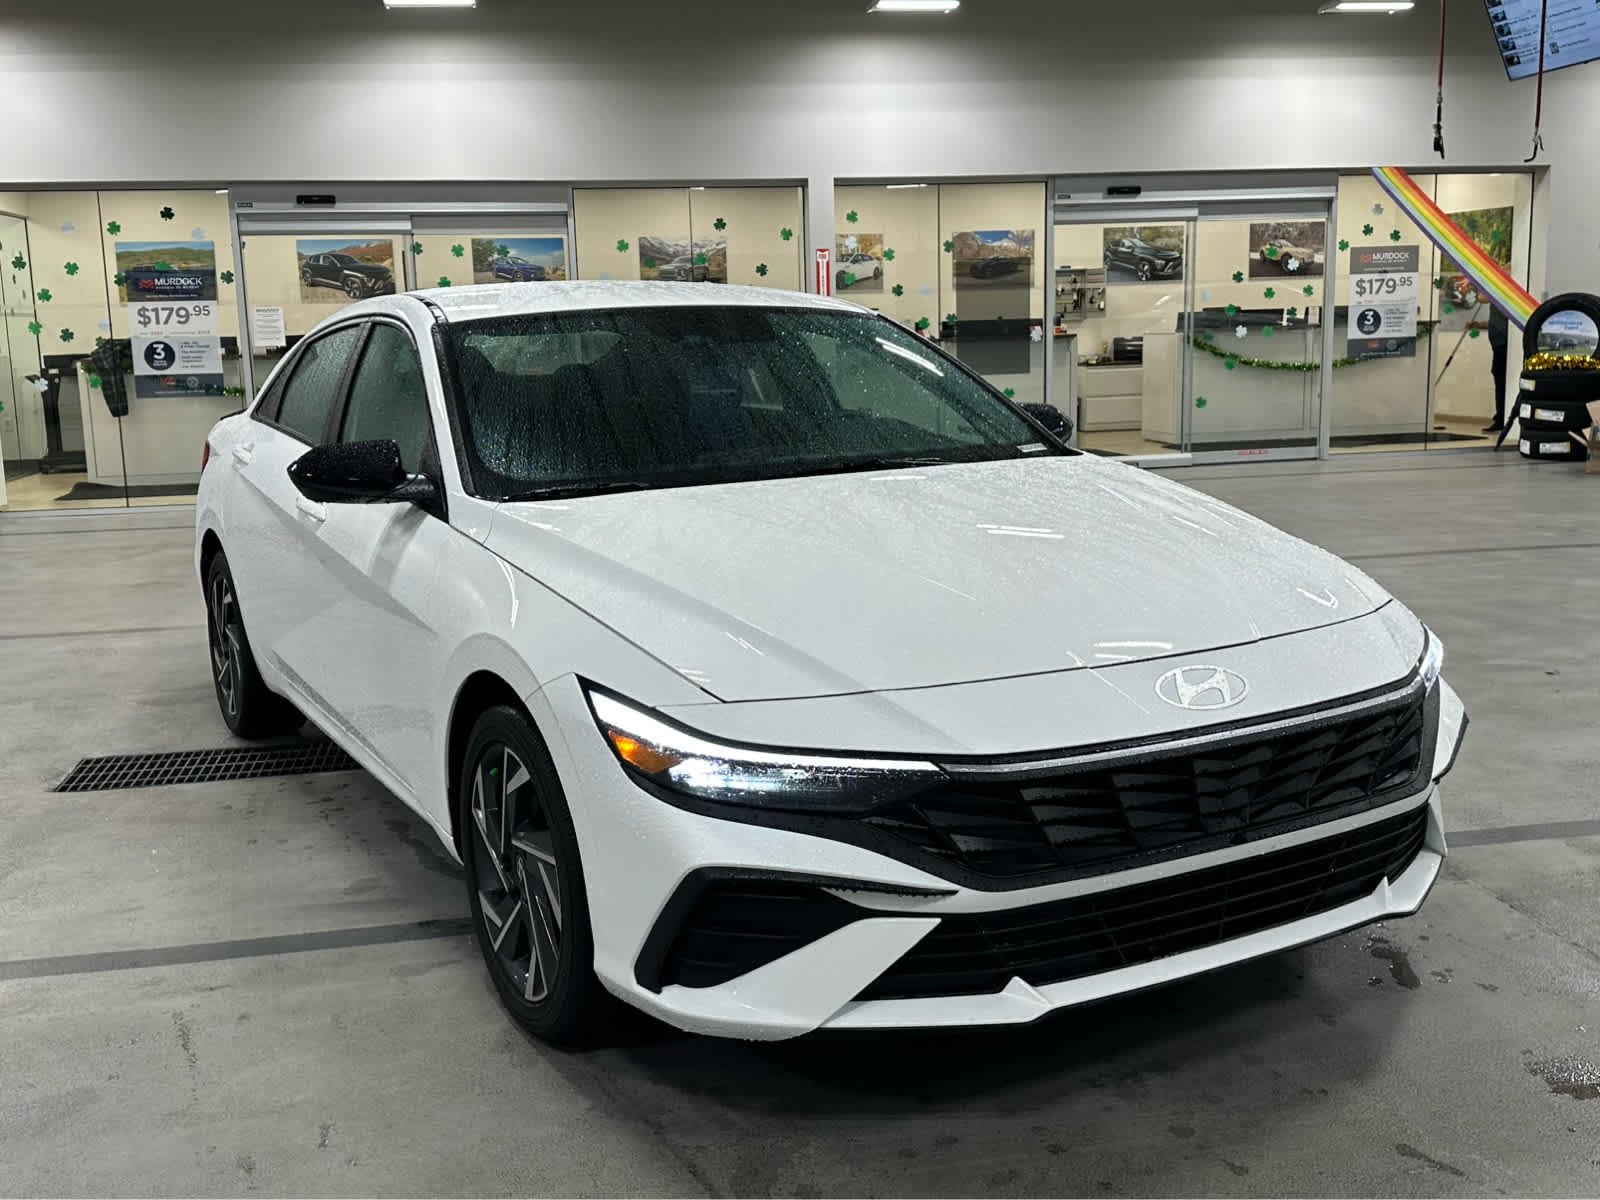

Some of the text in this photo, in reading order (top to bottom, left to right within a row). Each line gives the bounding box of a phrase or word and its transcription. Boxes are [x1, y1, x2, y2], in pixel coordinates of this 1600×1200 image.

[154, 277, 203, 286] MURDOCK
[1356, 277, 1413, 296] $179.95
[137, 305, 210, 327] $179.95
[1364, 311, 1374, 325] 3
[153, 344, 166, 359] 3
